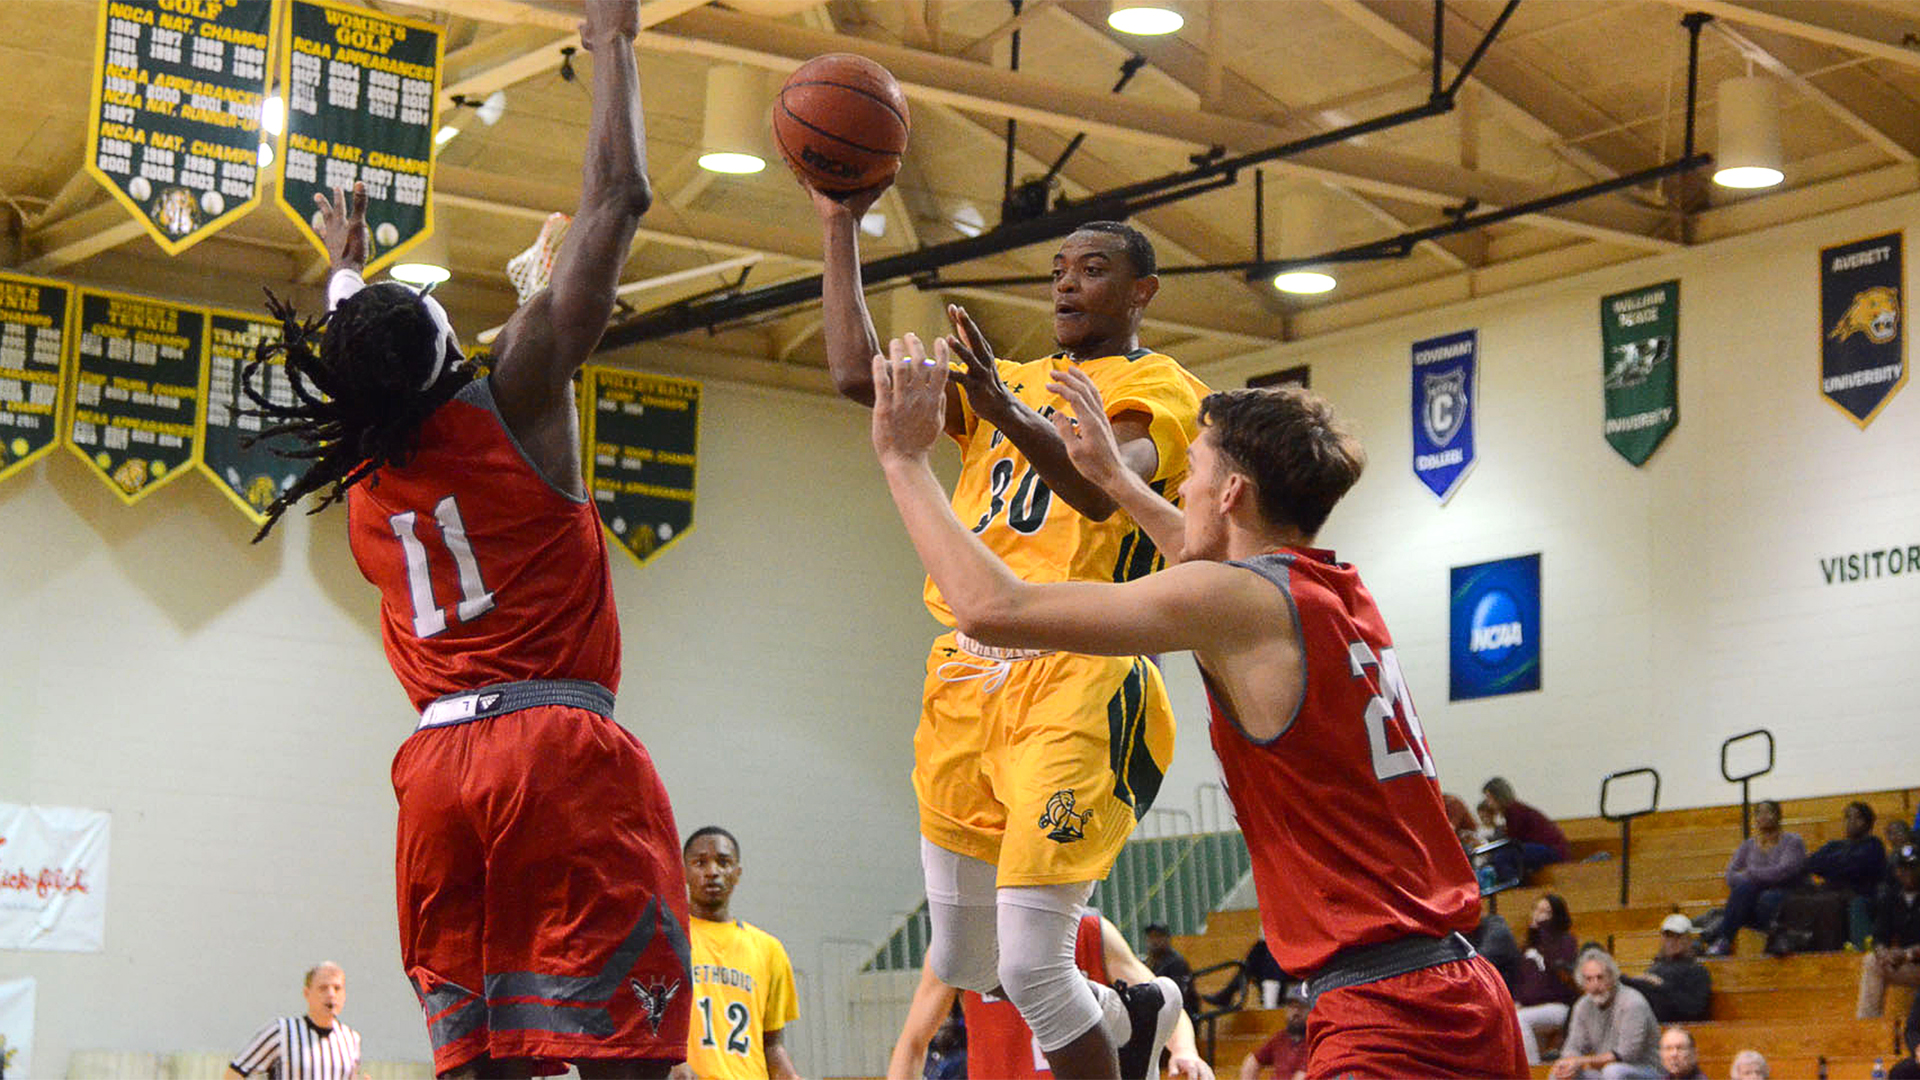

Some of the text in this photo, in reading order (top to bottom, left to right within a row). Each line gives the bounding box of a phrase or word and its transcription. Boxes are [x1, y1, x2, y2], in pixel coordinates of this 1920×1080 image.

[158, 0, 223, 21] GOLF
[324, 9, 407, 42] WOMEN'S
[159, 13, 195, 35] NAT.
[201, 22, 268, 50] CHAMPS
[335, 26, 395, 55] GOLF
[293, 36, 435, 81] NCAA APPEARANCES
[106, 63, 149, 86] NCAA
[104, 88, 143, 110] NCAA
[101, 120, 258, 166] NCAA NAT. CHAMPS
[289, 132, 328, 157] NCAA
[368, 150, 429, 177] CHAMPS
[1832, 245, 1891, 273] AVERETT
[1613, 290, 1666, 313] WILLIAM
[1414, 340, 1473, 366] COVENANT
[1824, 362, 1902, 393] UNIVERSITY
[1432, 393, 1454, 433] C
[1606, 405, 1673, 435] UNIVERSITY
[1416, 447, 1464, 472] COLLEGE
[972, 457, 1053, 535] 30
[389, 495, 496, 639] 11
[1820, 545, 1920, 585] VISITOR
[1470, 621, 1523, 653] NCAA
[693, 965, 758, 993] ETHODIS
[698, 997, 750, 1055] 12
